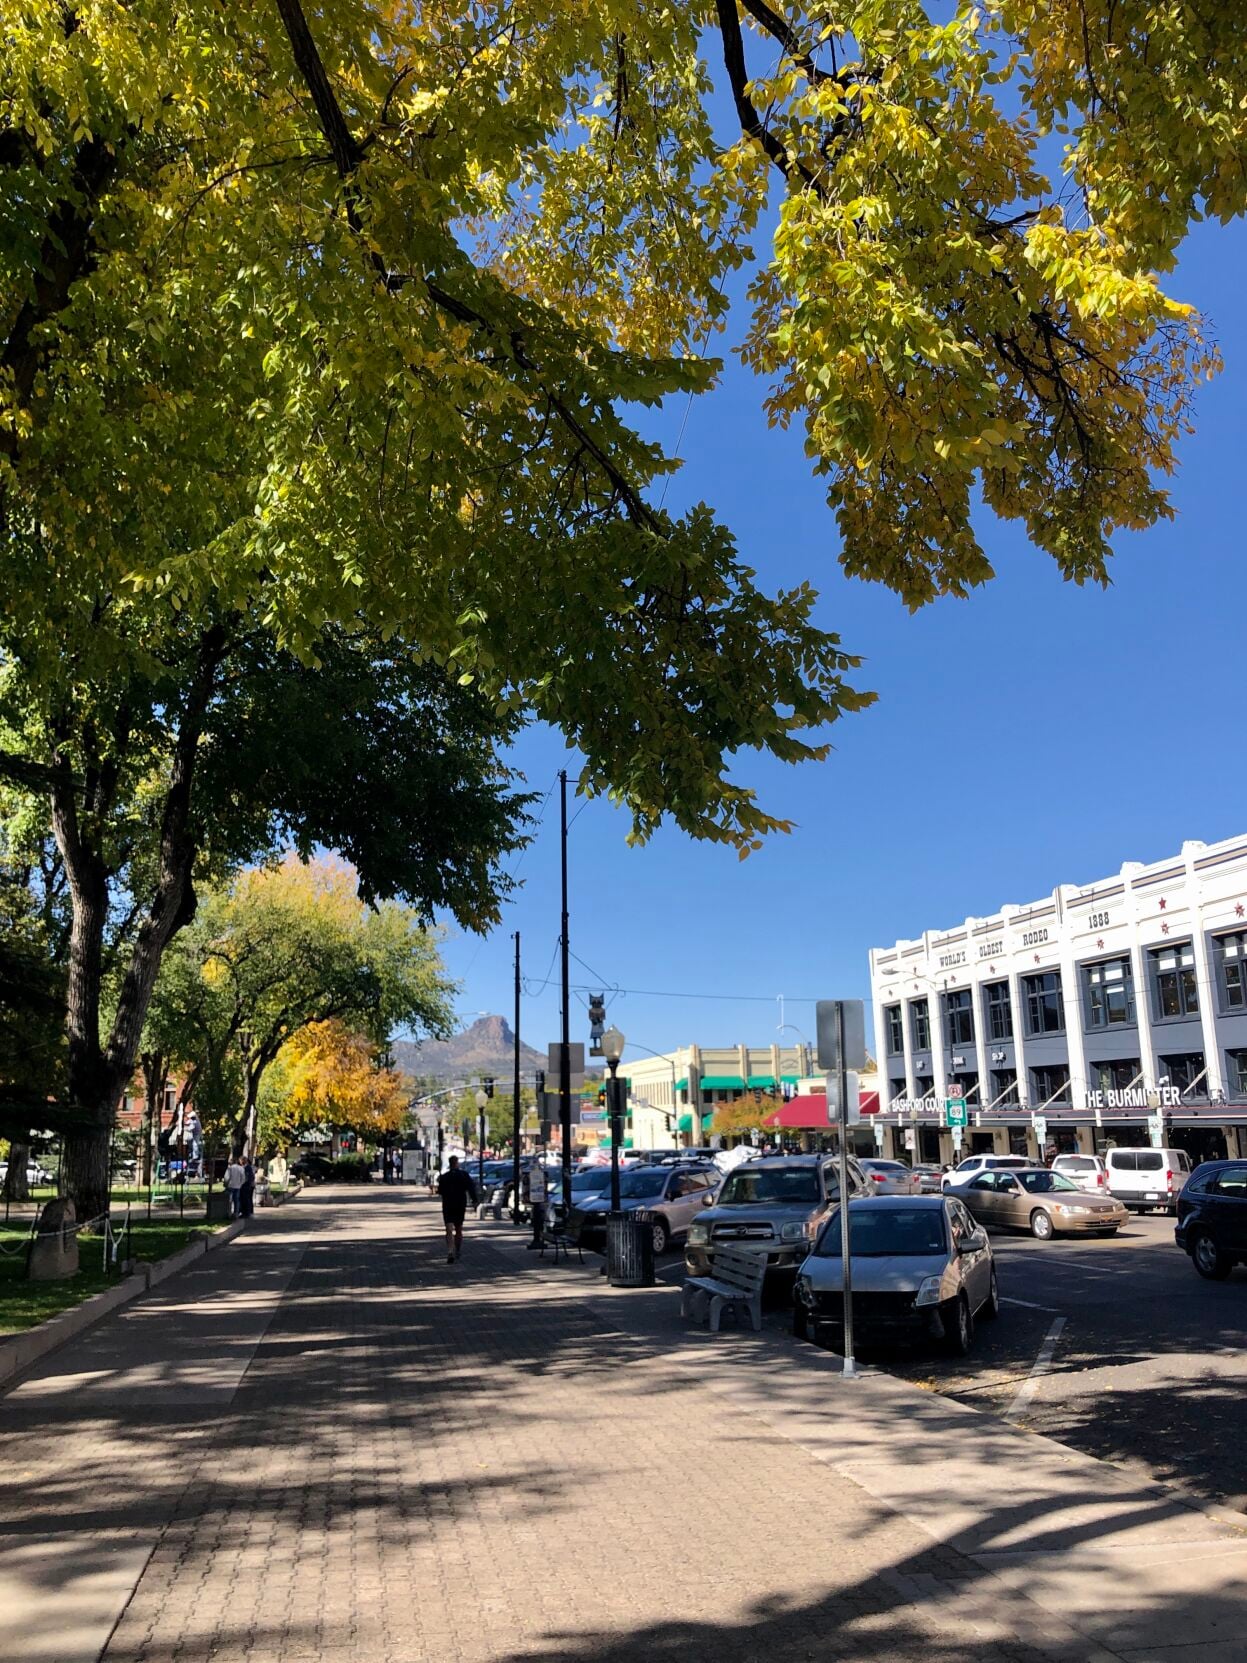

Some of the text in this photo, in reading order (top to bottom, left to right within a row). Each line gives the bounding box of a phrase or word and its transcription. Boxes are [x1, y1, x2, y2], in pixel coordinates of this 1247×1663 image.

[939, 911, 1110, 967] WORLD'S OLDEST RODEO 1888
[1083, 1089, 1104, 1108] THE
